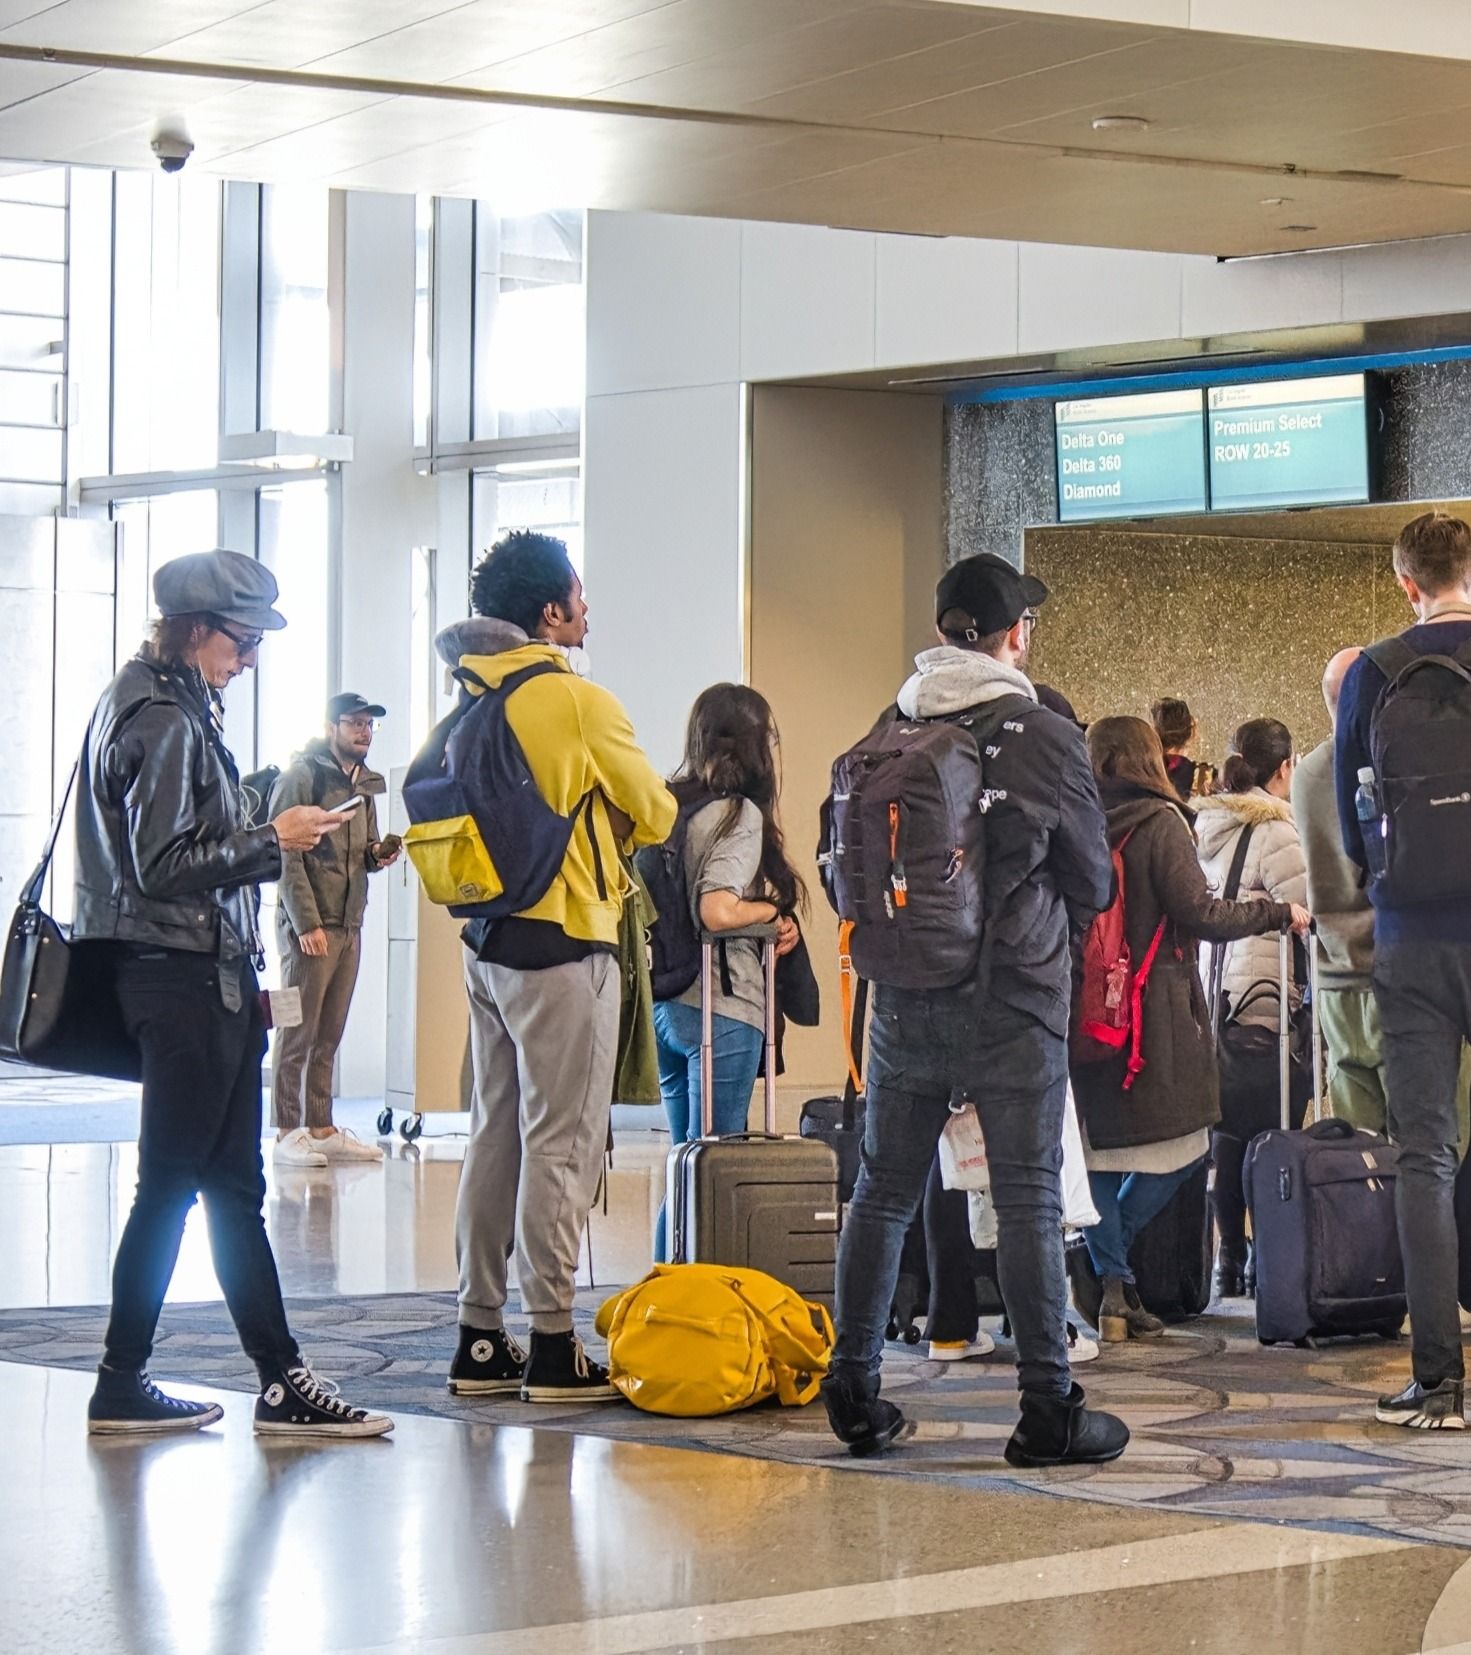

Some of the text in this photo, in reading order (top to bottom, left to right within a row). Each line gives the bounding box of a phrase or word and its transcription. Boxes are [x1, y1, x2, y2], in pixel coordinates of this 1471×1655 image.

[1214, 412, 1322, 437] Premium Select
[1061, 430, 1125, 450] Delta One
[1214, 441, 1291, 463] ROW 20-25
[1062, 455, 1122, 475] Delta 360
[1063, 480, 1122, 500] Diamond
[1003, 720, 1025, 733] ers
